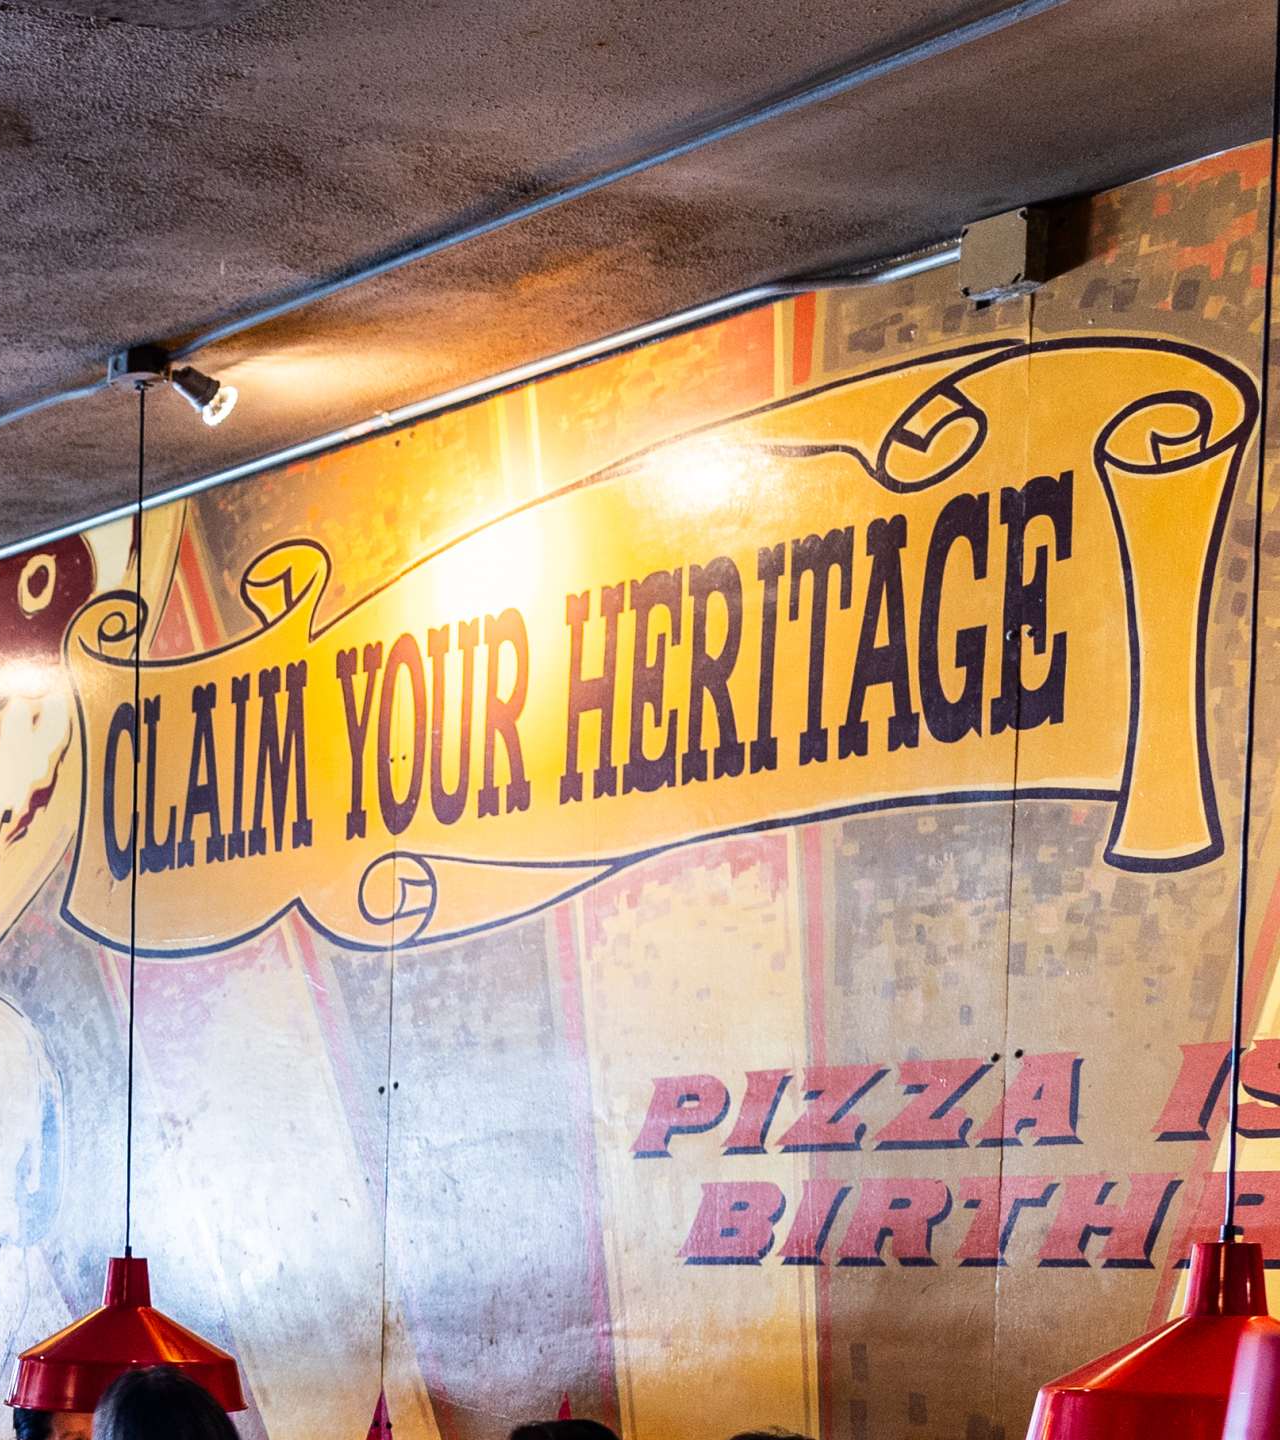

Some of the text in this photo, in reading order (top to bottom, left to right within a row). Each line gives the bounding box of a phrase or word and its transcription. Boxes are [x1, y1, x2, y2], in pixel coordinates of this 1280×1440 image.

[100, 470, 1076, 882] CLAIM YOUR HERITAGE
[631, 1052, 1083, 1158] PIZZA
